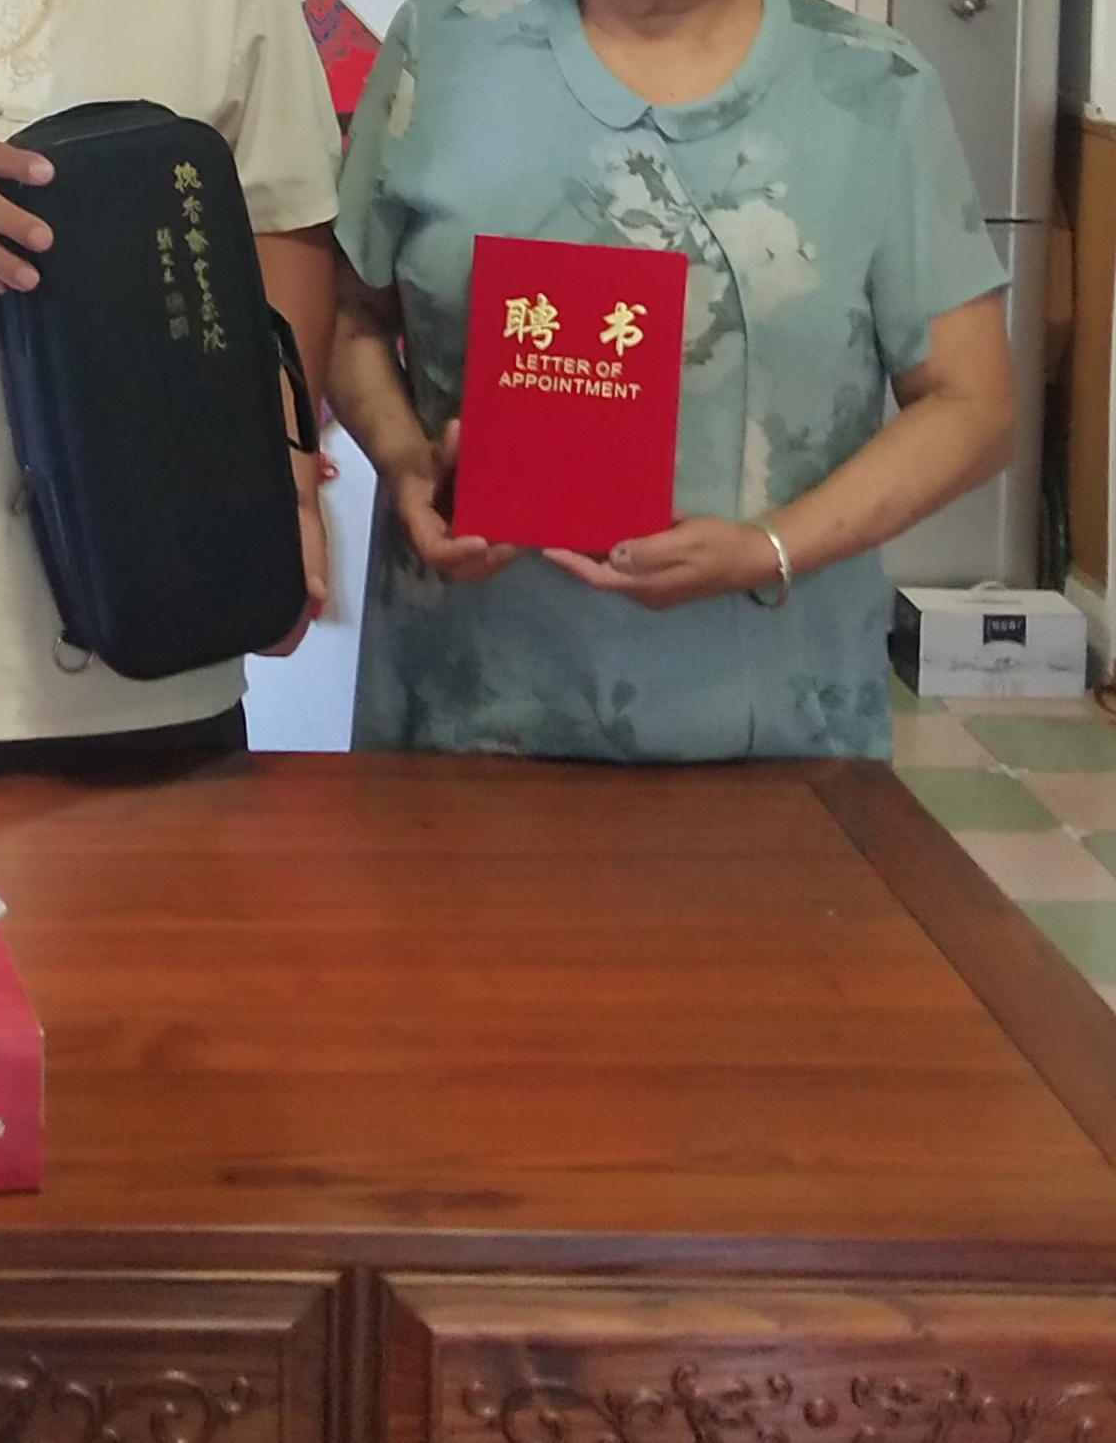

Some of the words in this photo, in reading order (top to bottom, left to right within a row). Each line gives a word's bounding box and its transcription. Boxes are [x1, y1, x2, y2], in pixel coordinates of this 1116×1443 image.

[503, 292, 647, 357] 聘书
[515, 353, 590, 375] LETTER
[595, 361, 623, 378] OF
[498, 371, 641, 400] APPOINTMENT
